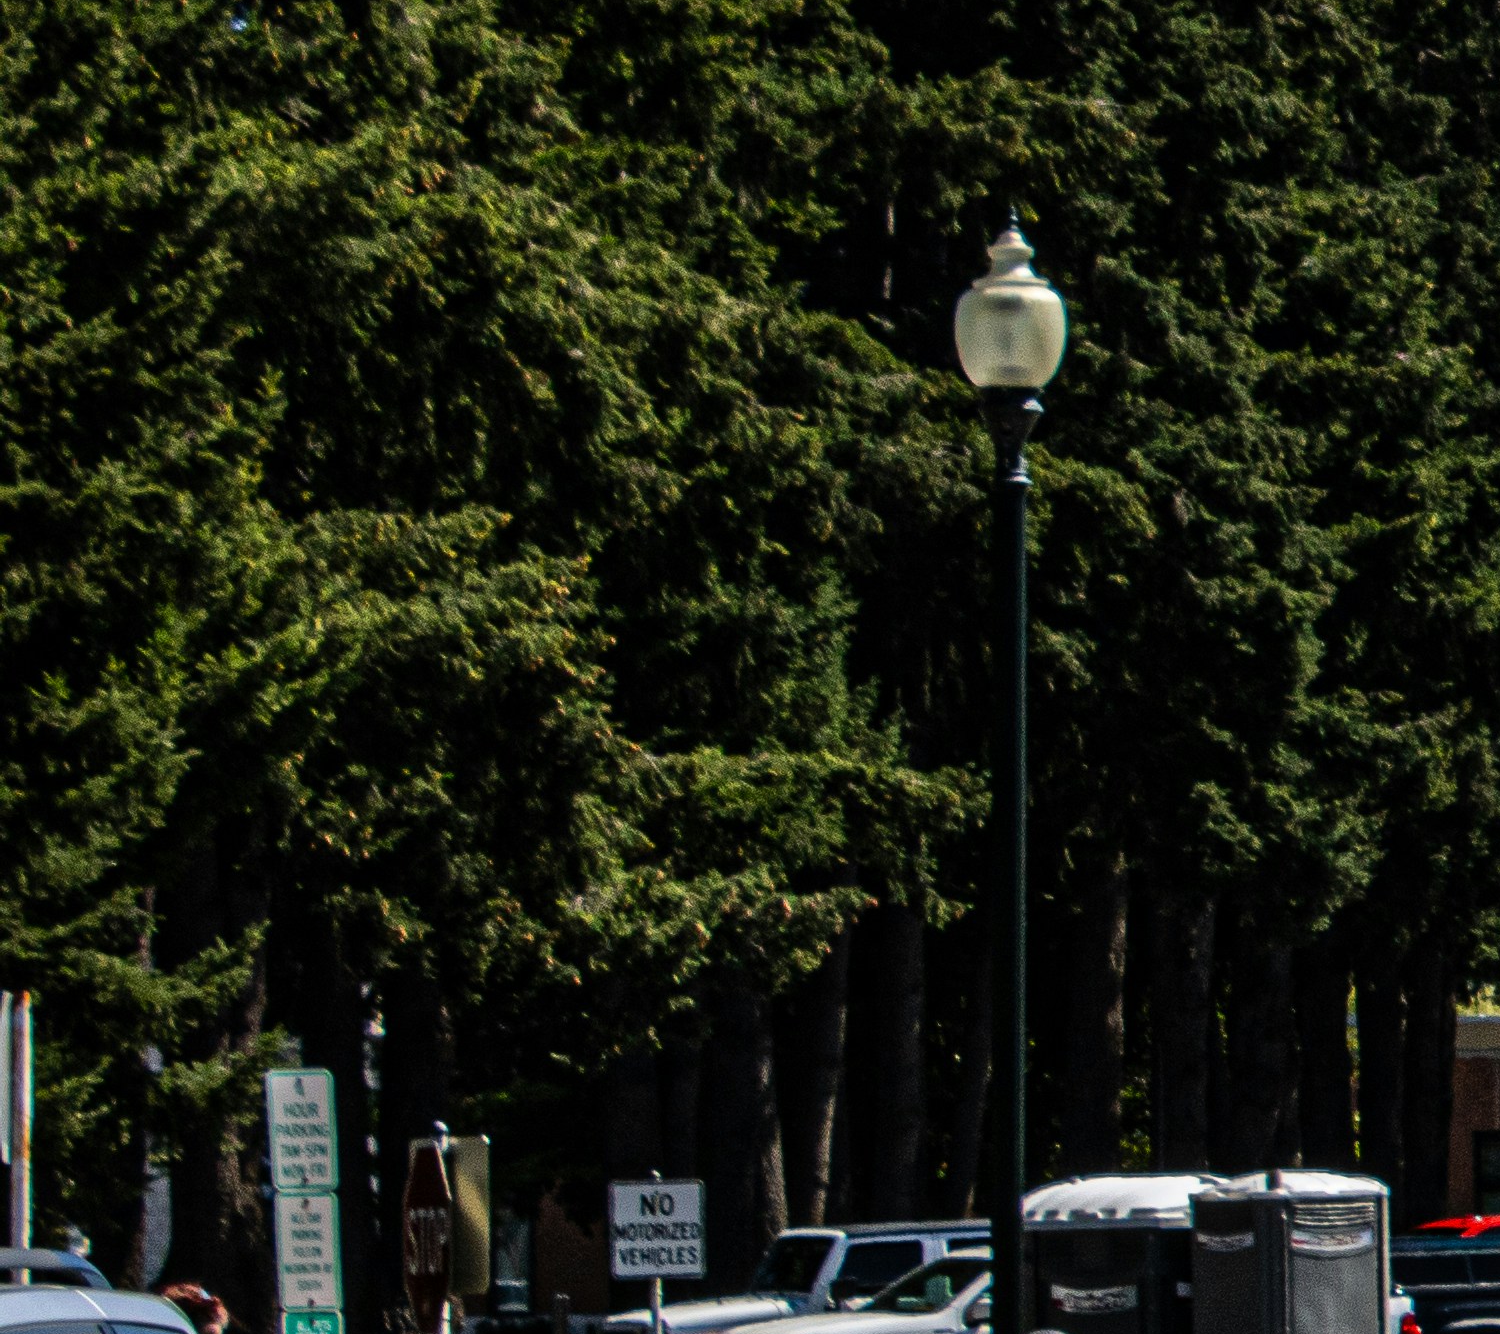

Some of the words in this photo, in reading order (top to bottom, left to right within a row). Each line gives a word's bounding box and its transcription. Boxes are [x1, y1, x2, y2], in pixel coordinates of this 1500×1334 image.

[283, 1102, 320, 1118] HOUR
[275, 1122, 330, 1137] PARKING
[640, 1191, 675, 1216] NO
[612, 1222, 700, 1241] MOTORIZED
[406, 1208, 447, 1275] STOP
[619, 1246, 697, 1266] VEHICLES
